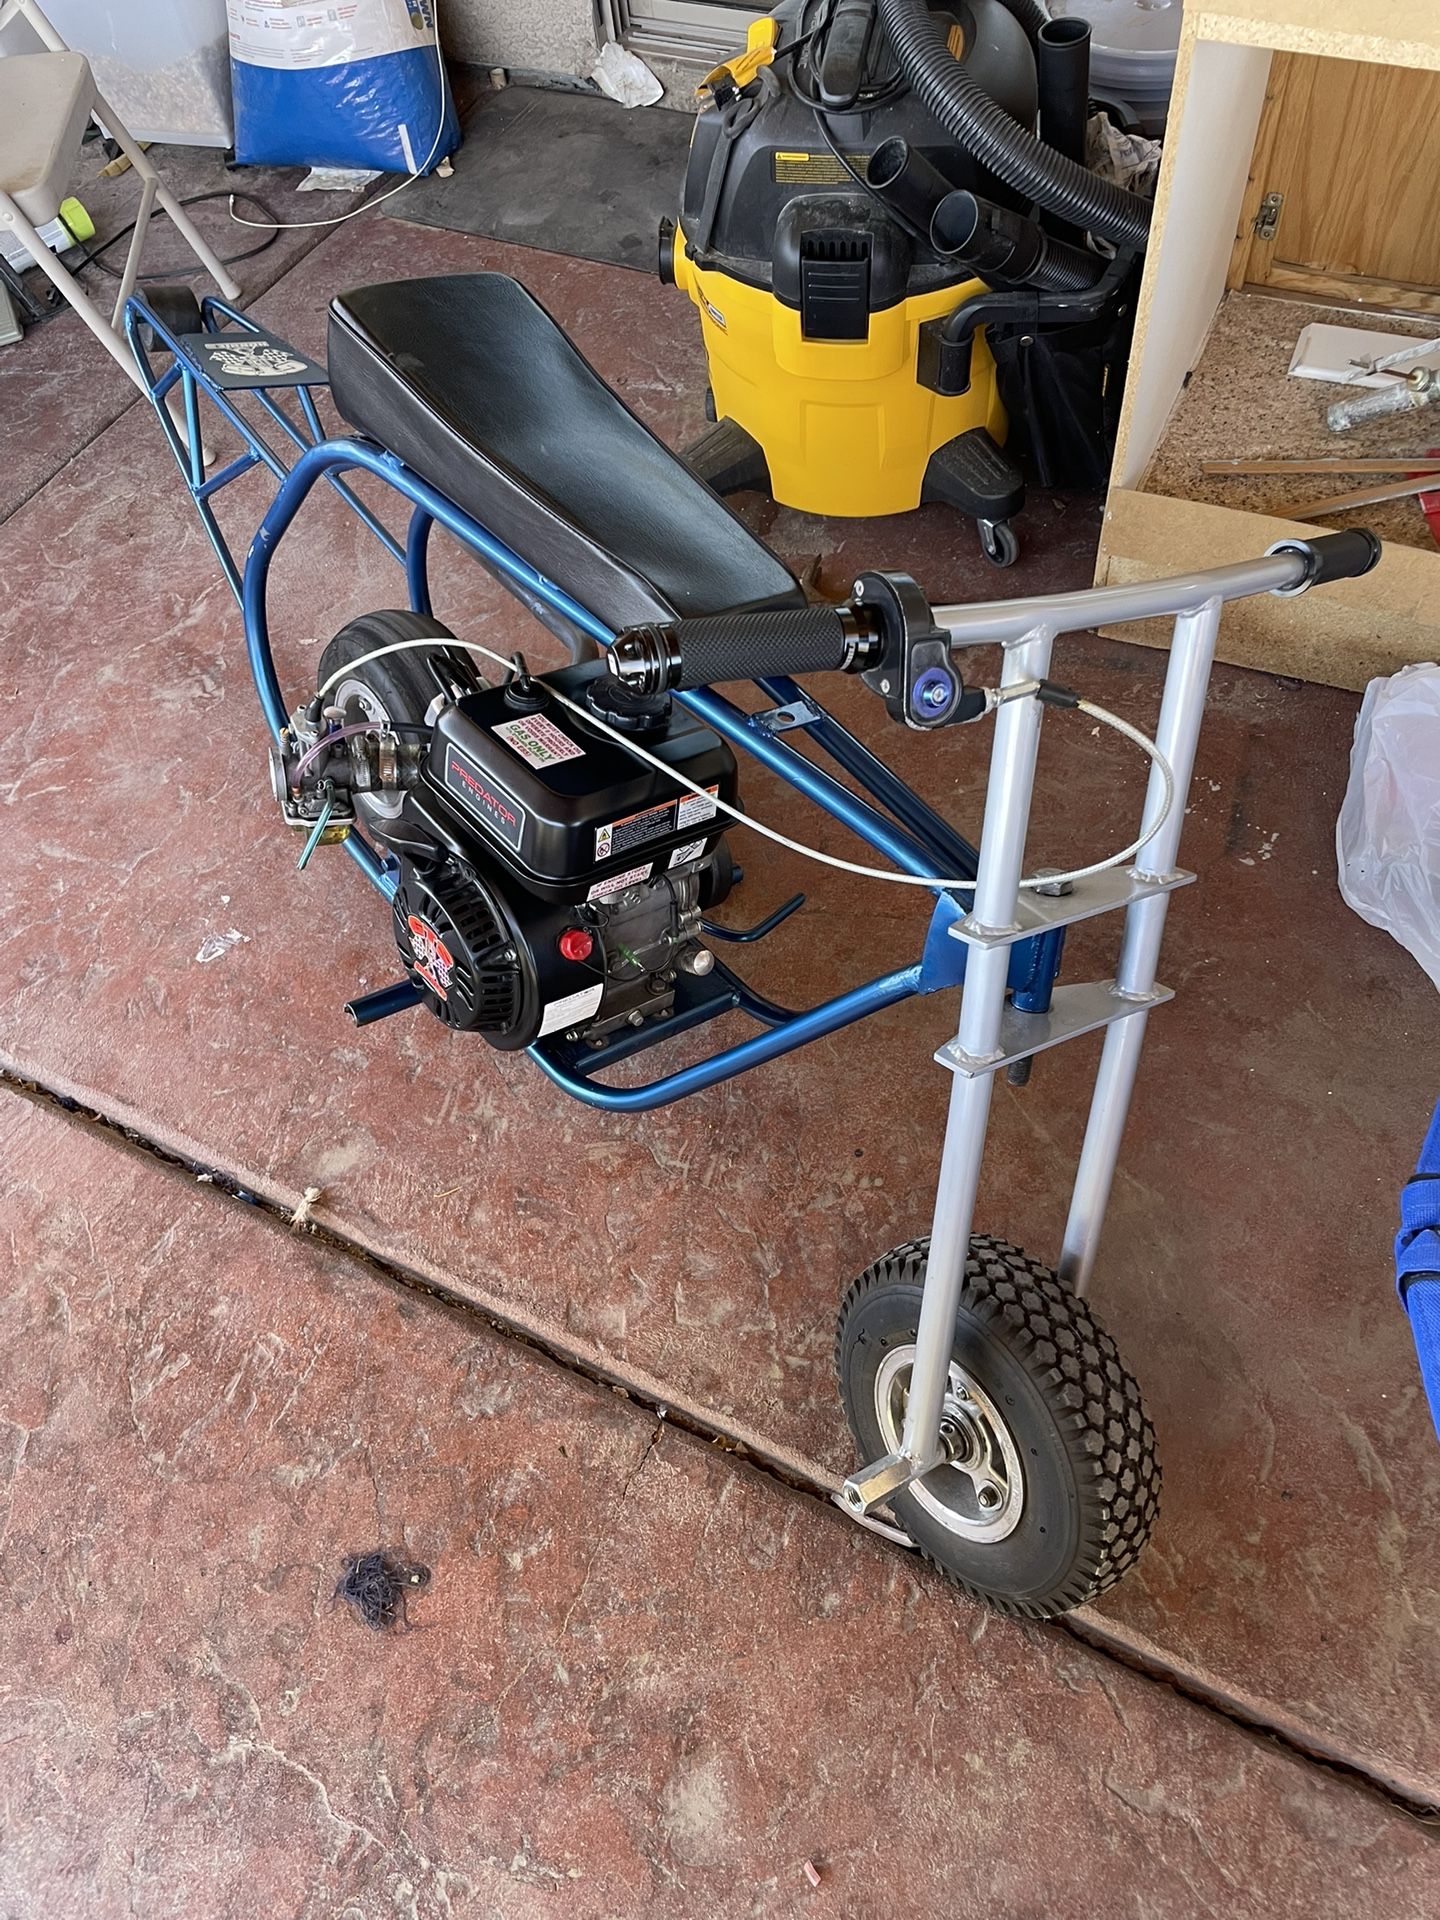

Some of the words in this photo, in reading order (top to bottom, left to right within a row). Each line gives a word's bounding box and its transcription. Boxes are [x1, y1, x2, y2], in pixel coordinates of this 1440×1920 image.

[509, 724, 531, 740] GAS
[527, 740, 555, 761] ONLY
[451, 760, 517, 828] PREDATOR
[462, 780, 505, 825] ENGINES
